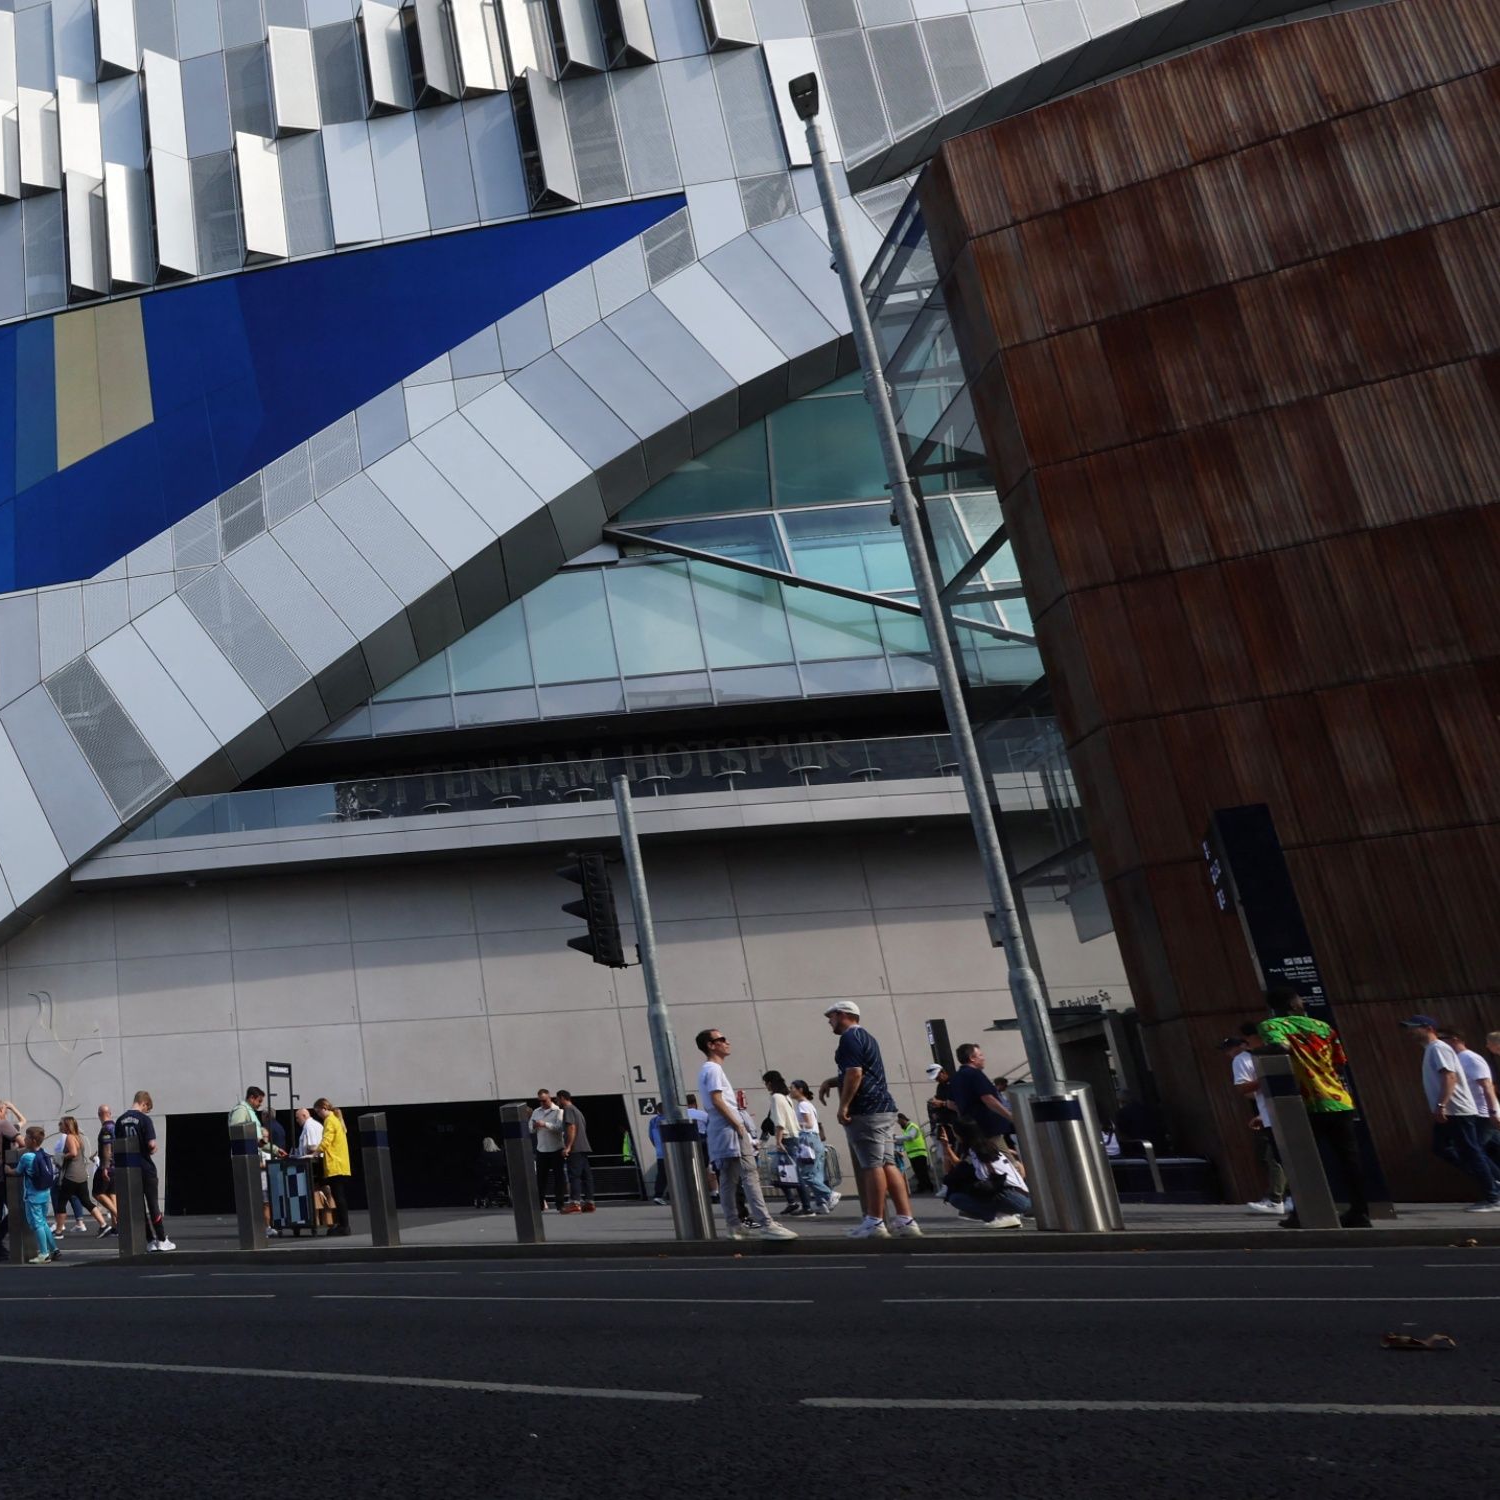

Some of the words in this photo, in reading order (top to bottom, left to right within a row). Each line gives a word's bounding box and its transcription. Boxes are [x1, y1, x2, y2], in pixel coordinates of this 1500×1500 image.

[342, 747, 608, 807] OTTENHAM
[622, 730, 852, 781] HOTSPUR
[633, 1065, 647, 1083] 1
